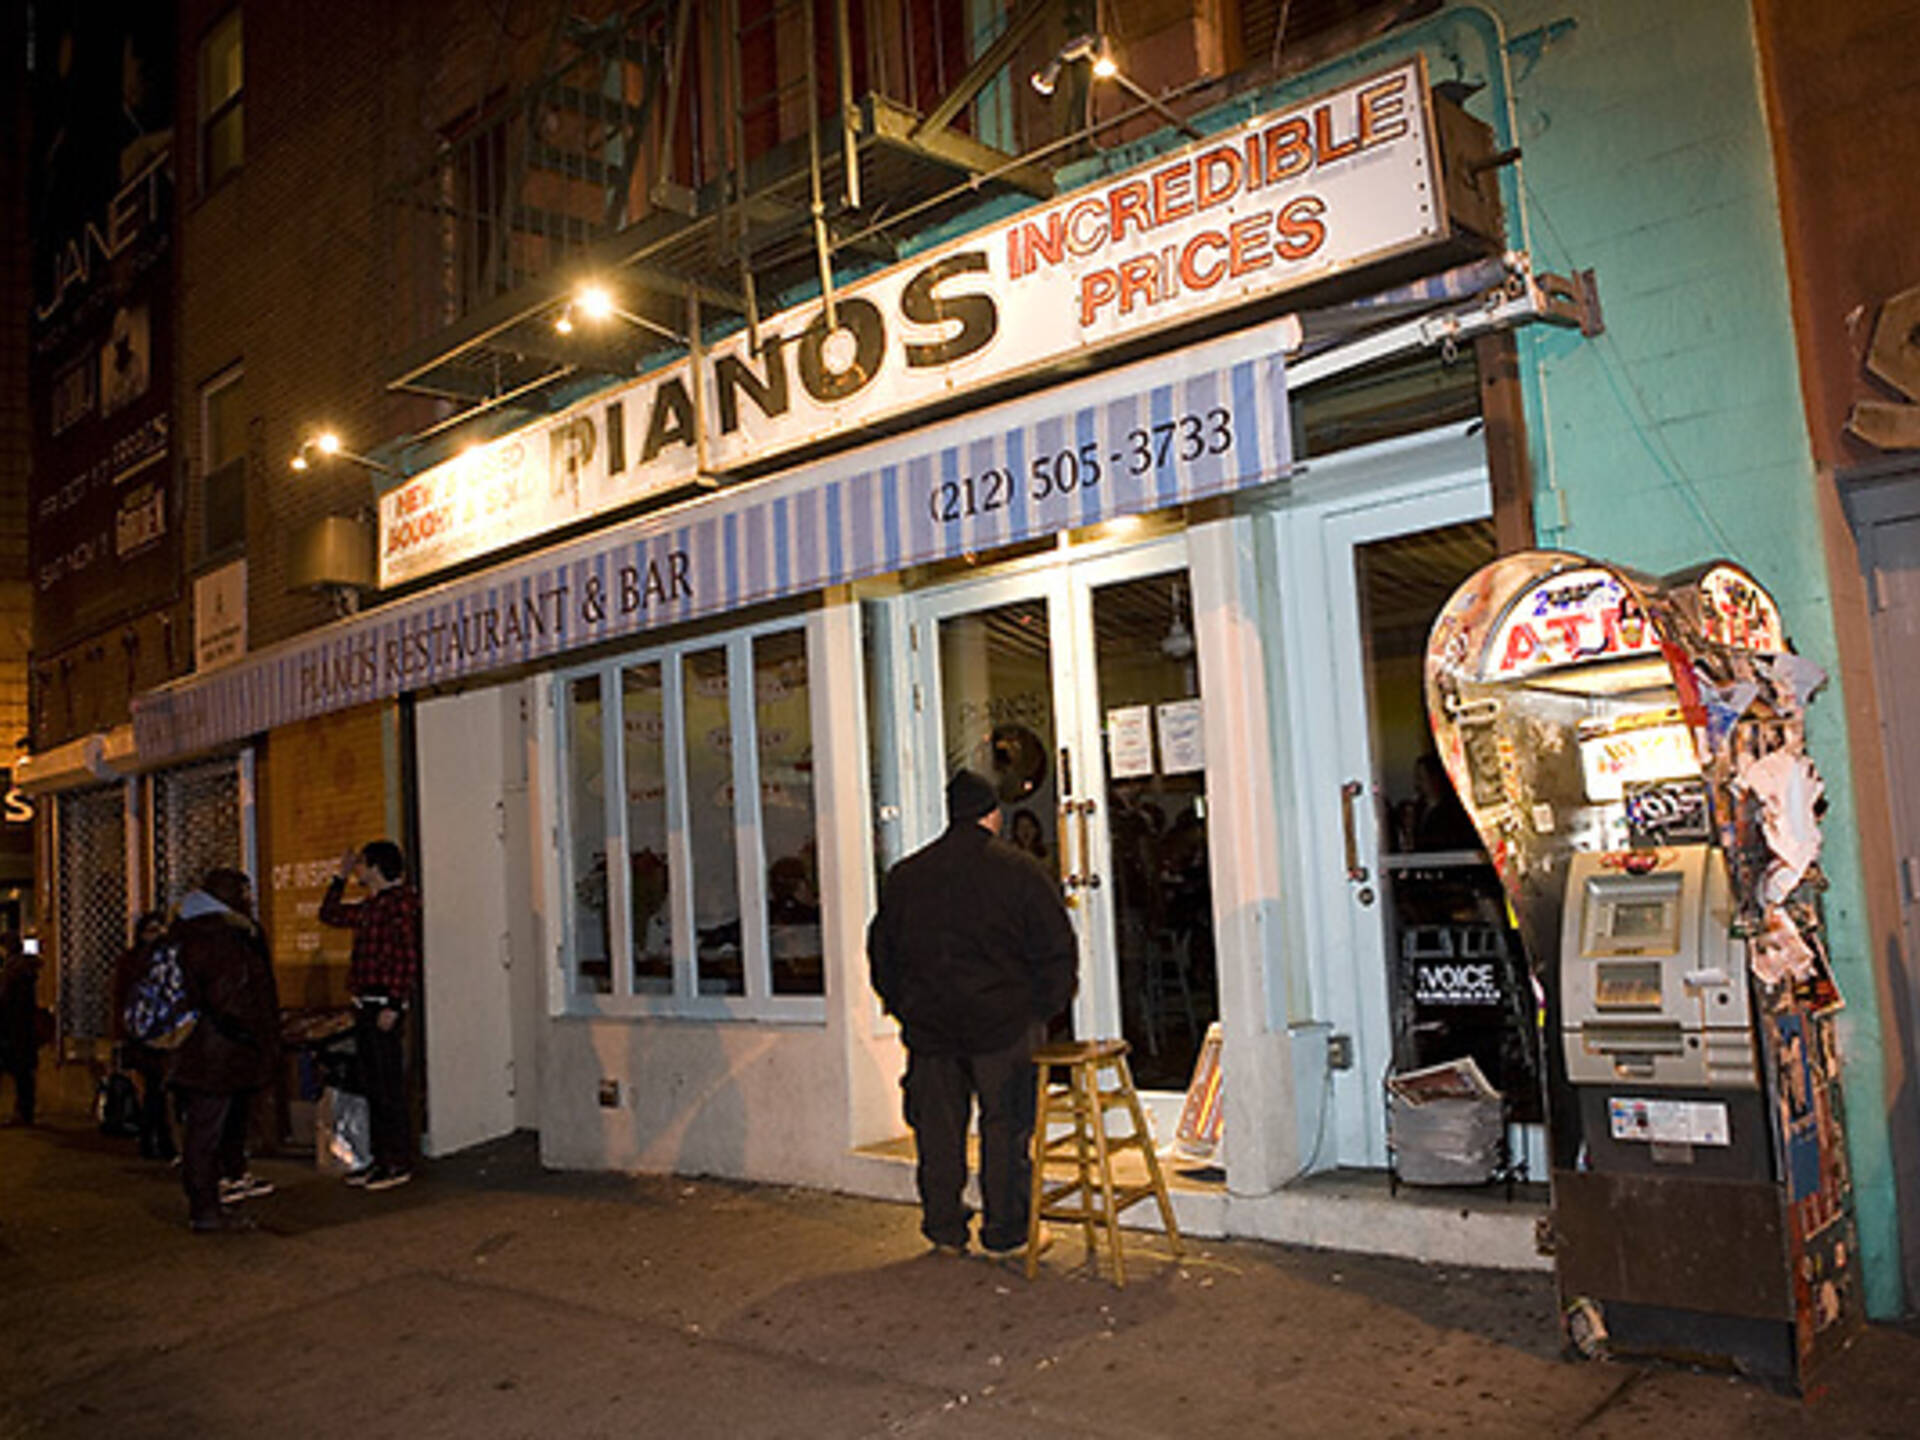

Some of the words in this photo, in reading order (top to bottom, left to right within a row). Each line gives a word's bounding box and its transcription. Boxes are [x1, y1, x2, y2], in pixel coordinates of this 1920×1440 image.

[37, 149, 170, 321] JANET
[1006, 72, 1408, 280] INCREDIBLE
[1079, 196, 1327, 326] PRICES
[549, 251, 998, 496] PIANOS
[930, 468, 1015, 522] (212)
[301, 644, 377, 704] PIANOS
[386, 586, 569, 680] RESTAURANT
[582, 576, 606, 623] &
[620, 551, 693, 614] BAR
